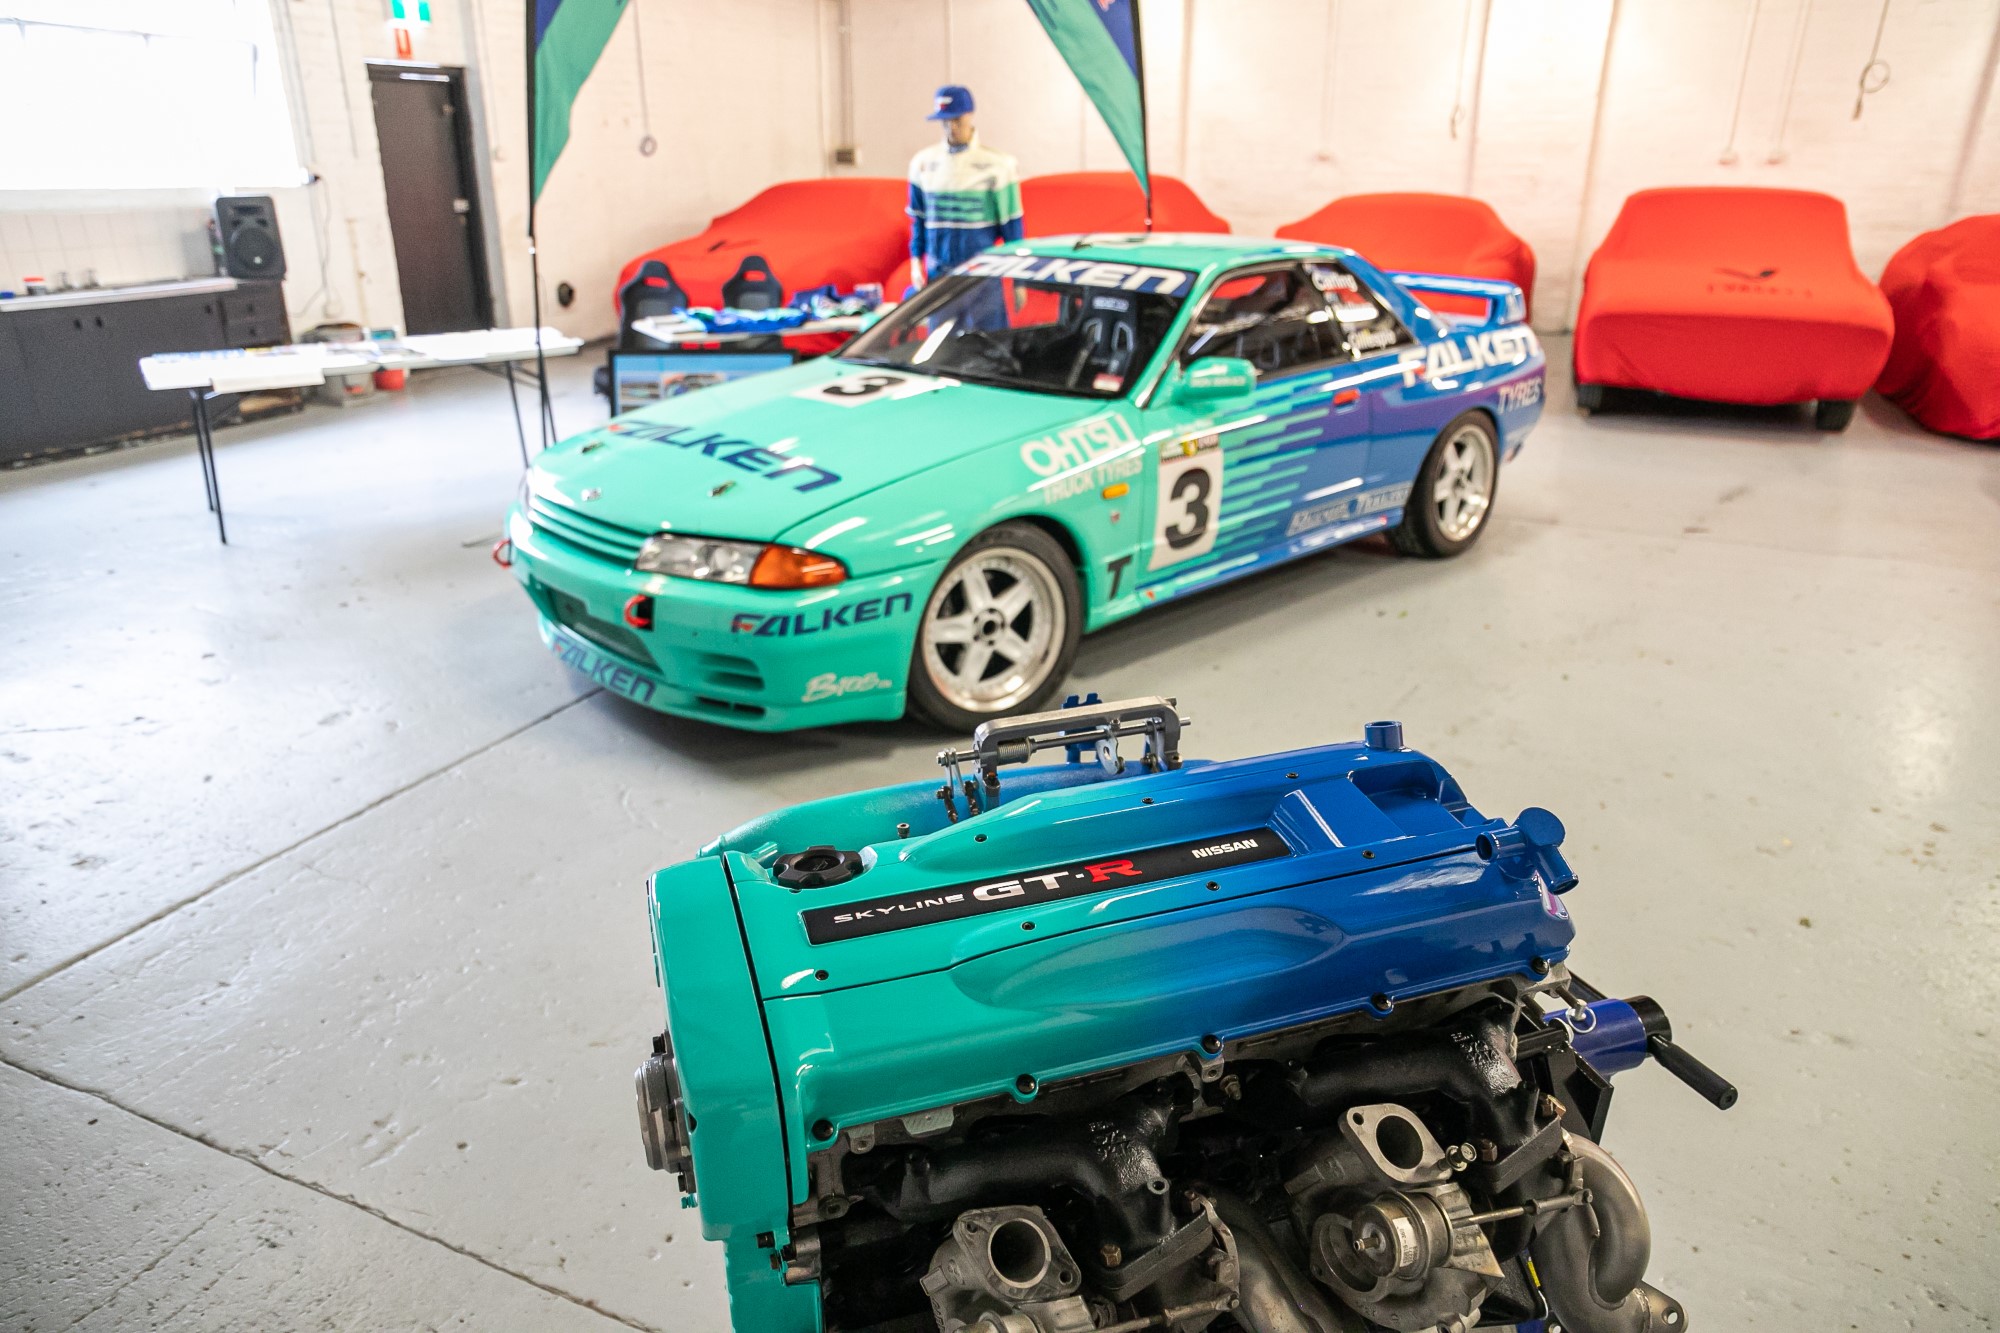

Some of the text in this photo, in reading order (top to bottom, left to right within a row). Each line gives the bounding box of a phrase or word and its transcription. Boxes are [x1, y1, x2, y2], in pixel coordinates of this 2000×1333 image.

[951, 254, 1187, 295] FALKEN
[1398, 322, 1540, 388] FALKEN
[1497, 376, 1542, 414] TYRES
[592, 419, 842, 493] FALKEN
[1020, 412, 1138, 477] OHTSU
[1043, 452, 1143, 505] TRUCK TYRES
[1165, 468, 1210, 549] 3
[1107, 554, 1133, 600] T
[730, 591, 913, 637] FALKEN
[553, 635, 656, 703] FALKEN
[833, 893, 965, 924] SKYLINE
[1191, 838, 1259, 861] NISSAN
